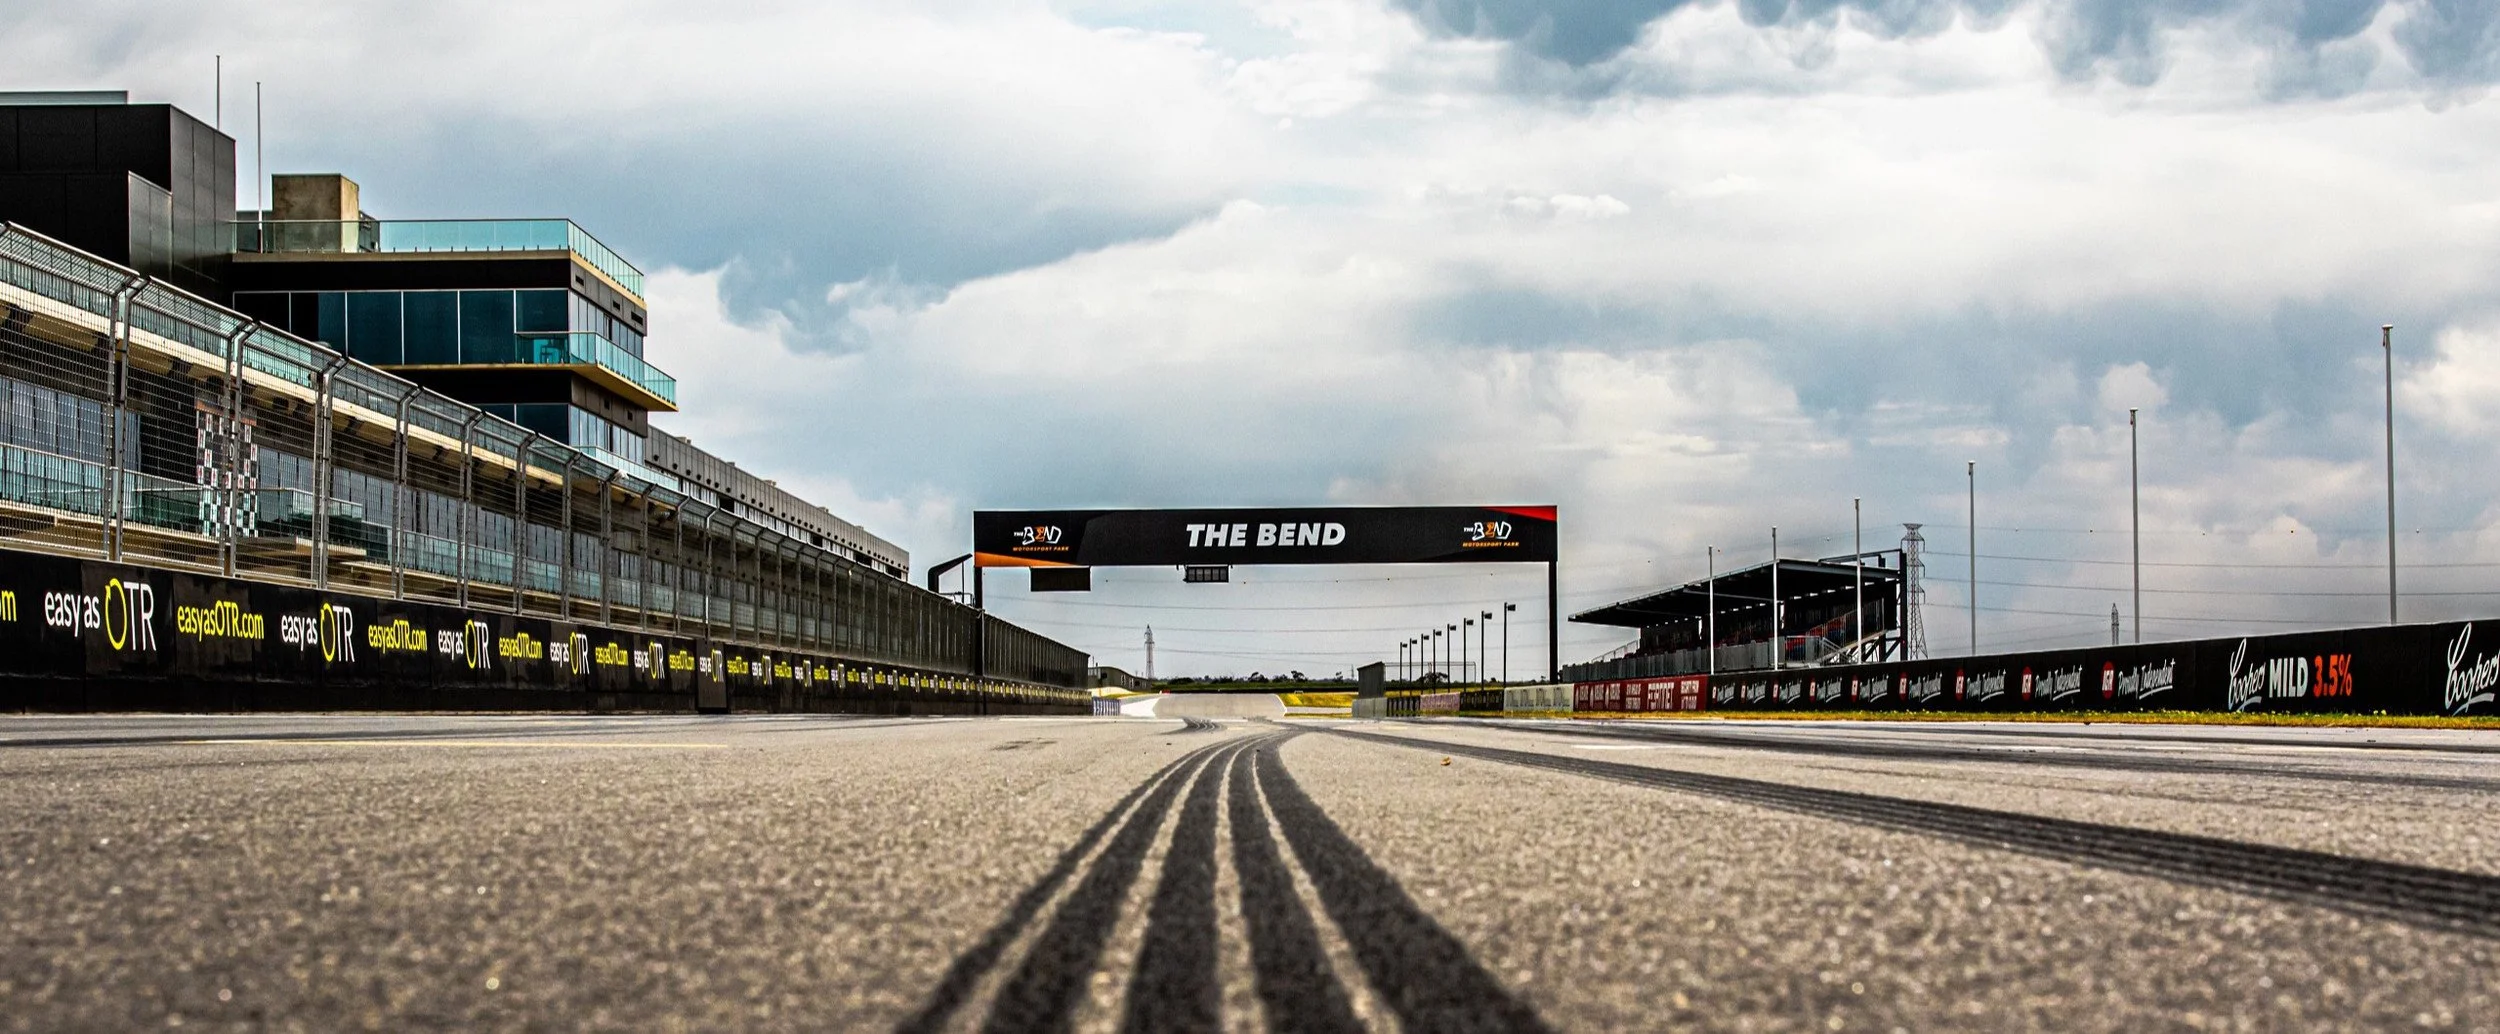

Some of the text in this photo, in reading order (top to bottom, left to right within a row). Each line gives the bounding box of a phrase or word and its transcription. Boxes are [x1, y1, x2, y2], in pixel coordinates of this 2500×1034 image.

[1186, 522, 1346, 547] THE BEND
[44, 578, 157, 652] easy as OTR
[177, 600, 265, 642] easyasOTR.com
[281, 603, 356, 662] easy as OTR
[368, 619, 428, 655] easyasOTR.com
[438, 619, 491, 670] easy as OTR
[569, 631, 590, 675] OTR
[2228, 637, 2353, 712] Coopers MILD 3.5%
